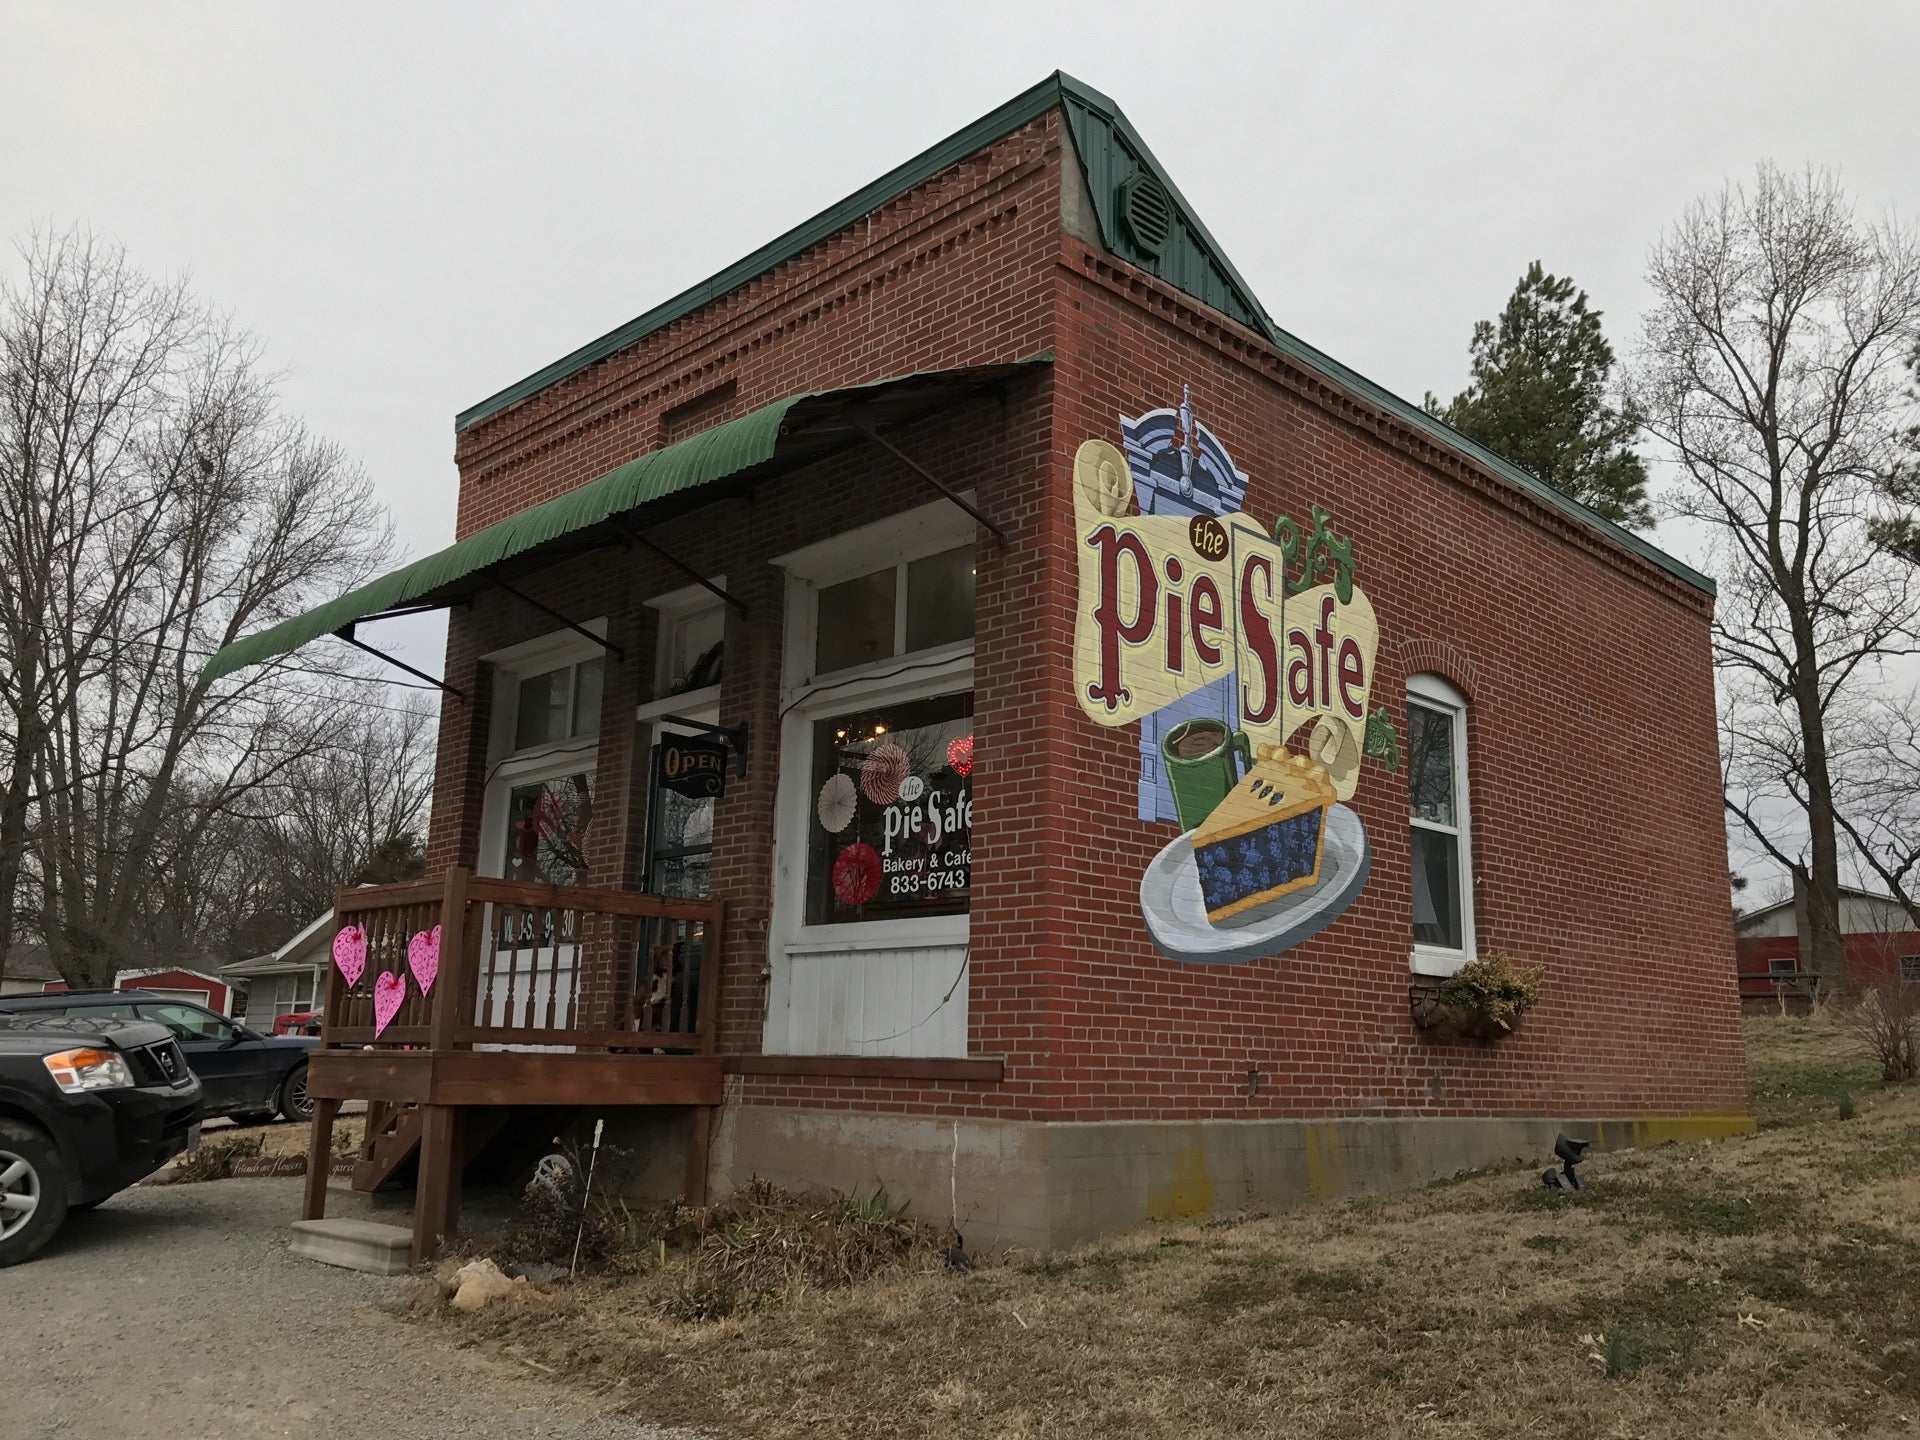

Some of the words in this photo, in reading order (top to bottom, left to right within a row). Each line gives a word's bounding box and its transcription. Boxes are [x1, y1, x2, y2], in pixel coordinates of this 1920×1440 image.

[1193, 520, 1224, 555] the
[1239, 553, 1366, 727] Safe
[902, 779, 920, 797] the
[927, 789, 973, 845] Safe
[883, 857, 925, 873] Bakery
[929, 853, 939, 868] &
[944, 850, 972, 867] Cafe
[890, 869, 965, 894] 833-6743
